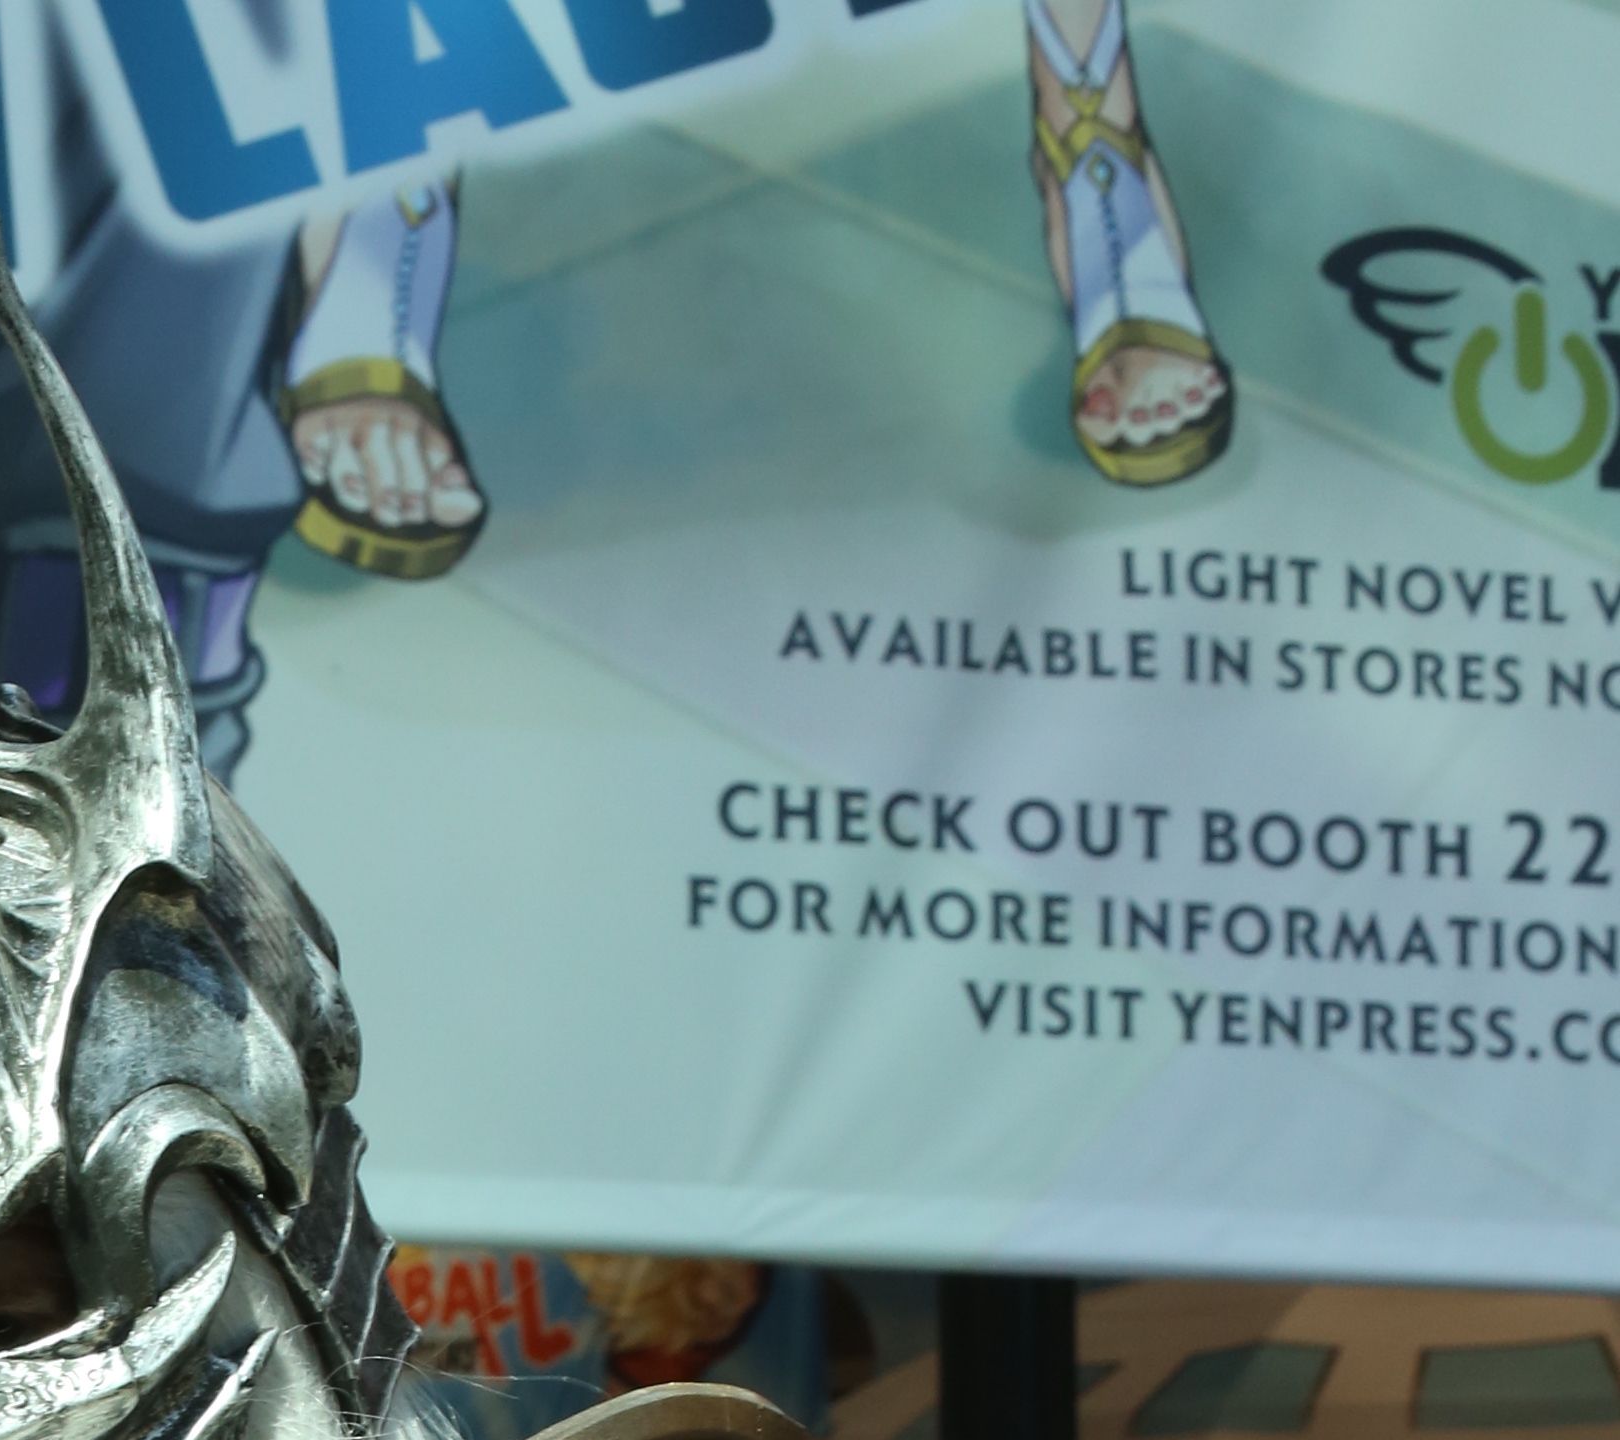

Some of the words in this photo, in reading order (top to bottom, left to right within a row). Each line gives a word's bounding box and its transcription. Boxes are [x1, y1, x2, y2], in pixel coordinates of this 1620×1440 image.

[1120, 548, 1321, 608] LIGHT
[1345, 562, 1568, 626] NOVEL
[777, 610, 1160, 683] AVAILABLE
[1183, 632, 1253, 689] IN
[1274, 639, 1524, 707] STORES
[715, 779, 977, 853] CHECK
[1005, 796, 1172, 863] OUT
[1199, 807, 1472, 881] BOOTH
[685, 873, 835, 937] FOR
[854, 885, 1073, 952] MORE
[1097, 895, 1620, 977] INFORMATION
[962, 979, 1146, 1042] VISIT
